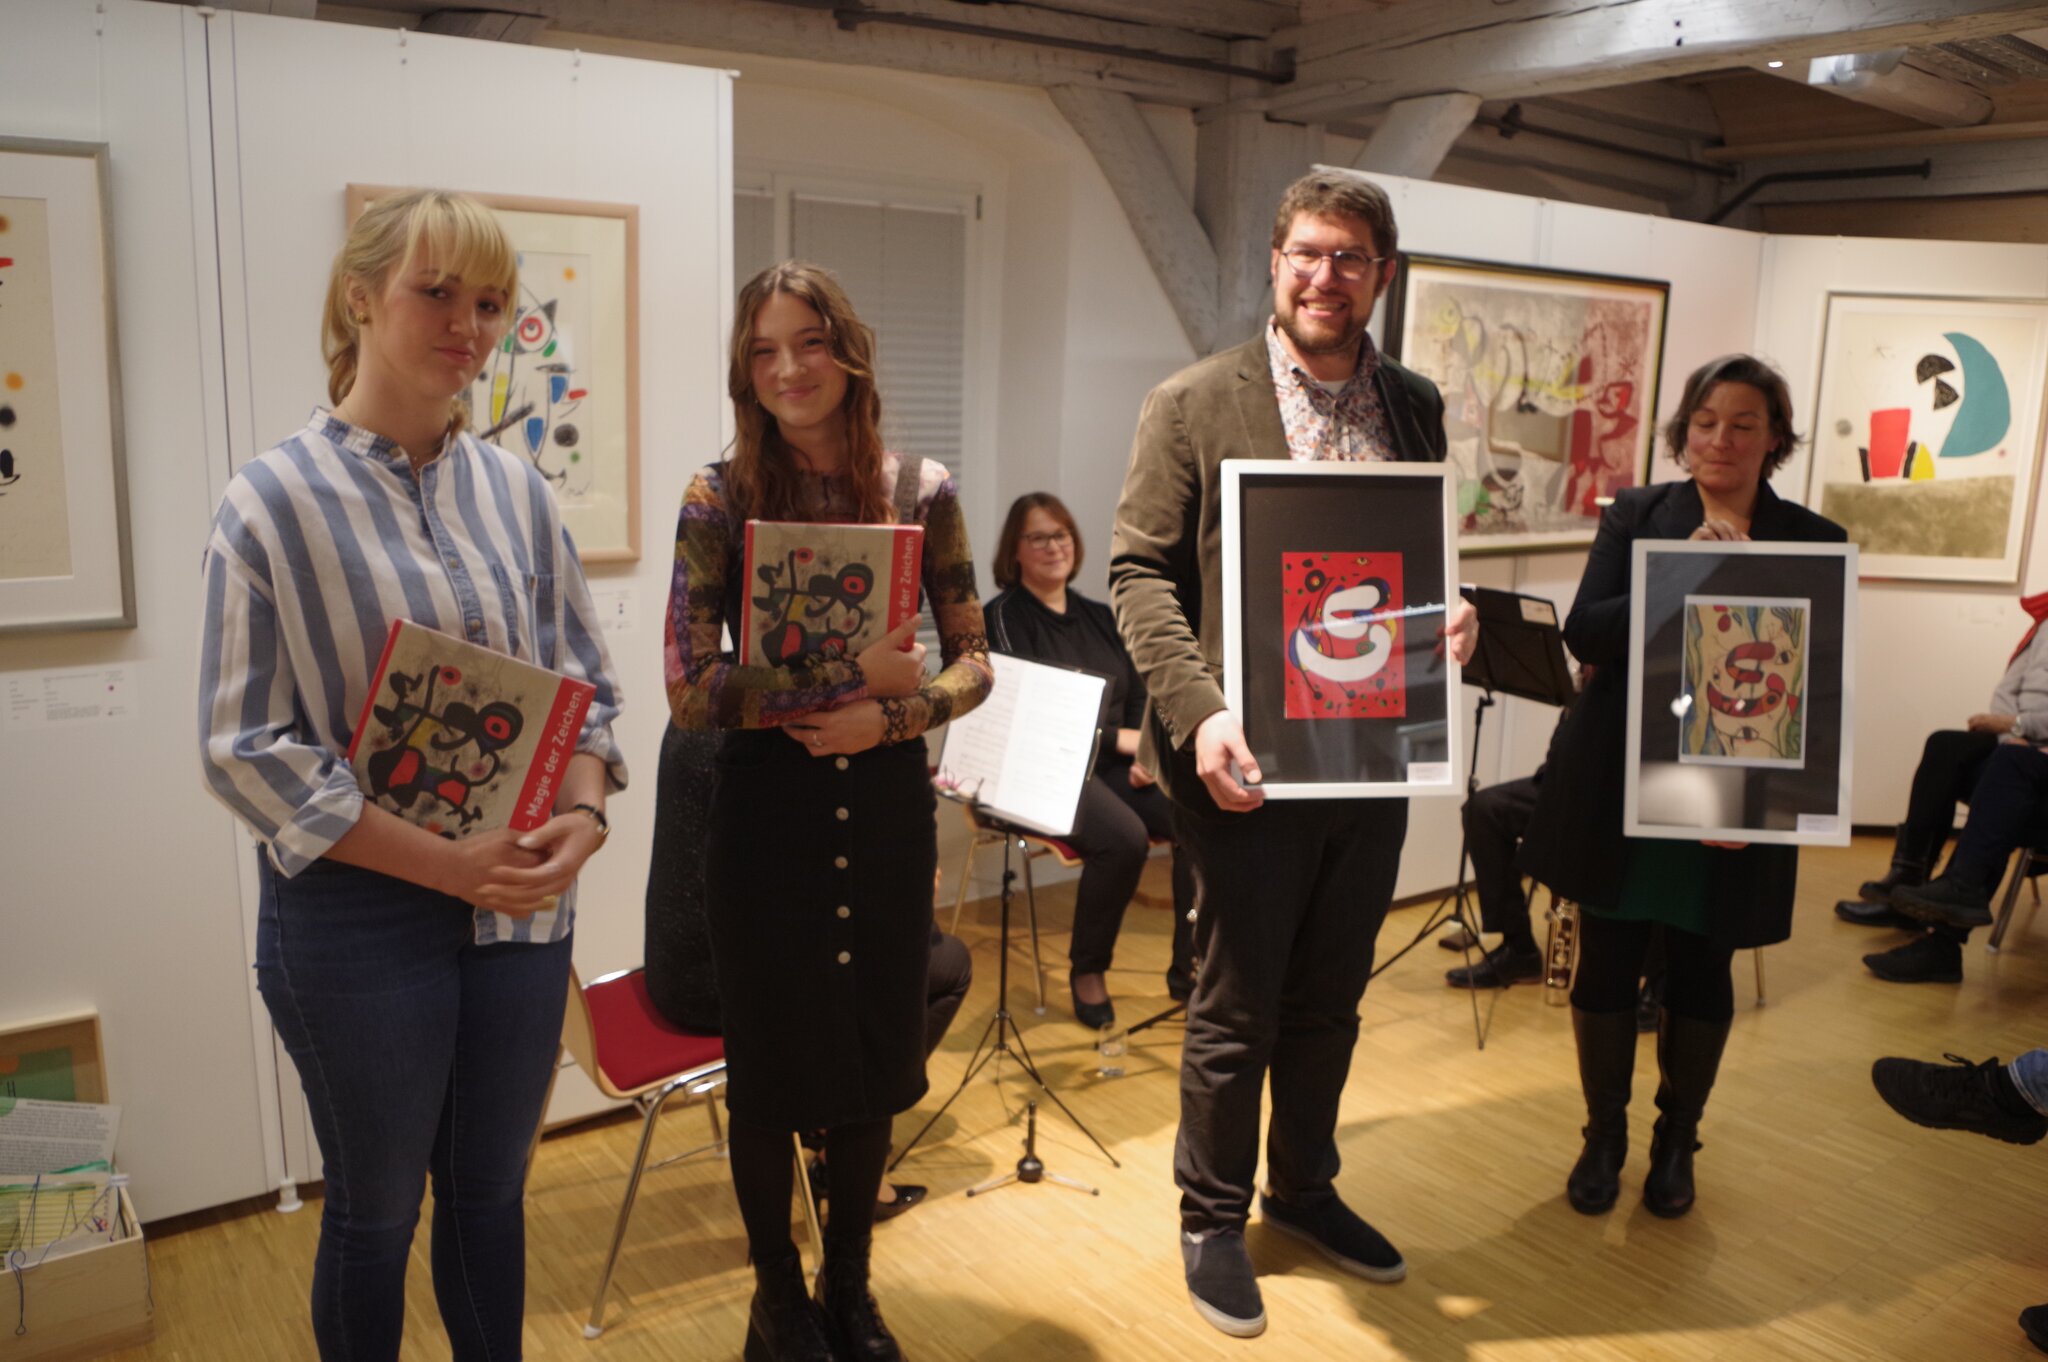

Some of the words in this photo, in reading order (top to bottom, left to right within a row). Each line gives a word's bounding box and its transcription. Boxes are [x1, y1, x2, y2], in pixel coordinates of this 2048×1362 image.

[900, 536, 914, 584] Zeichen
[899, 589, 910, 608] der
[526, 775, 551, 817] Magie
[544, 750, 560, 772] der
[552, 691, 582, 746] Zeichen
